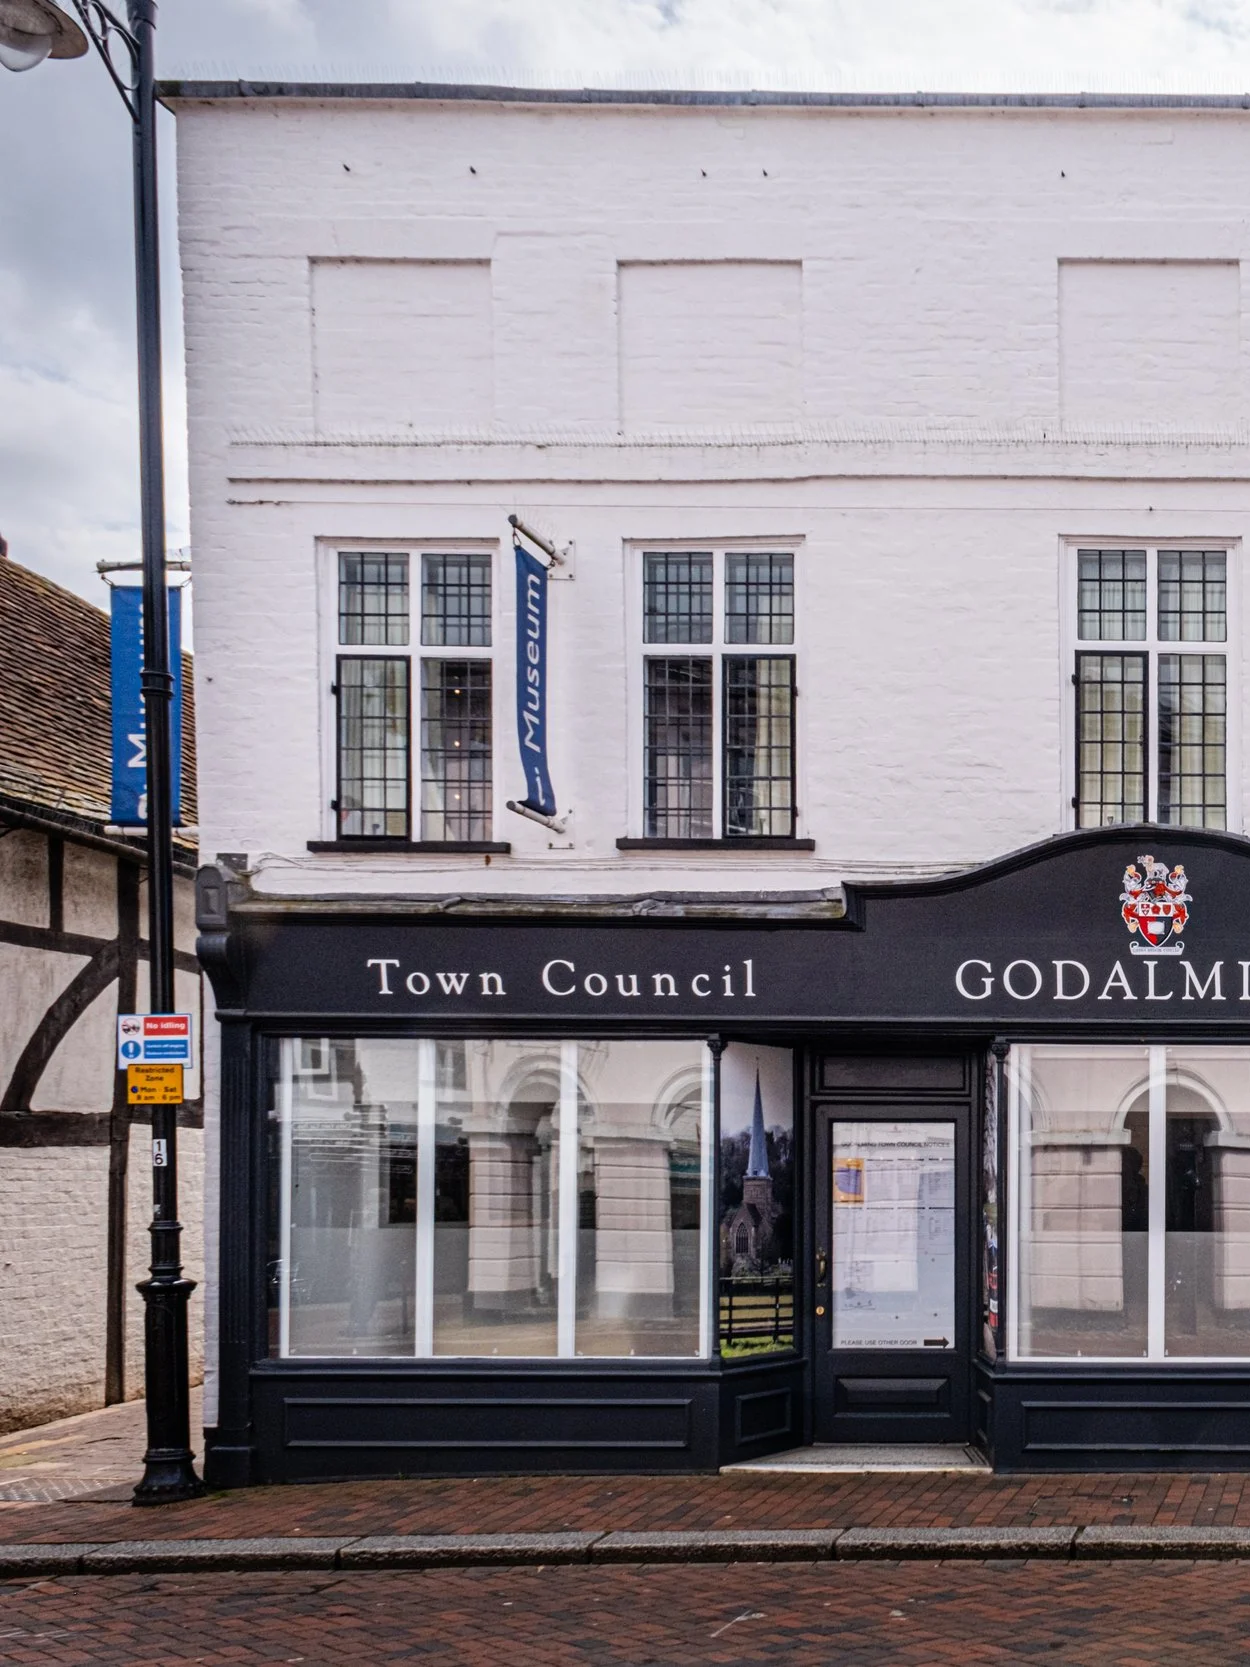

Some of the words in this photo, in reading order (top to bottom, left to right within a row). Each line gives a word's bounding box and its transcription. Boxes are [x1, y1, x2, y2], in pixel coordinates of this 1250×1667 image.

[523, 574, 541, 752] Museum
[367, 958, 506, 996] Town
[542, 959, 757, 997] Council
